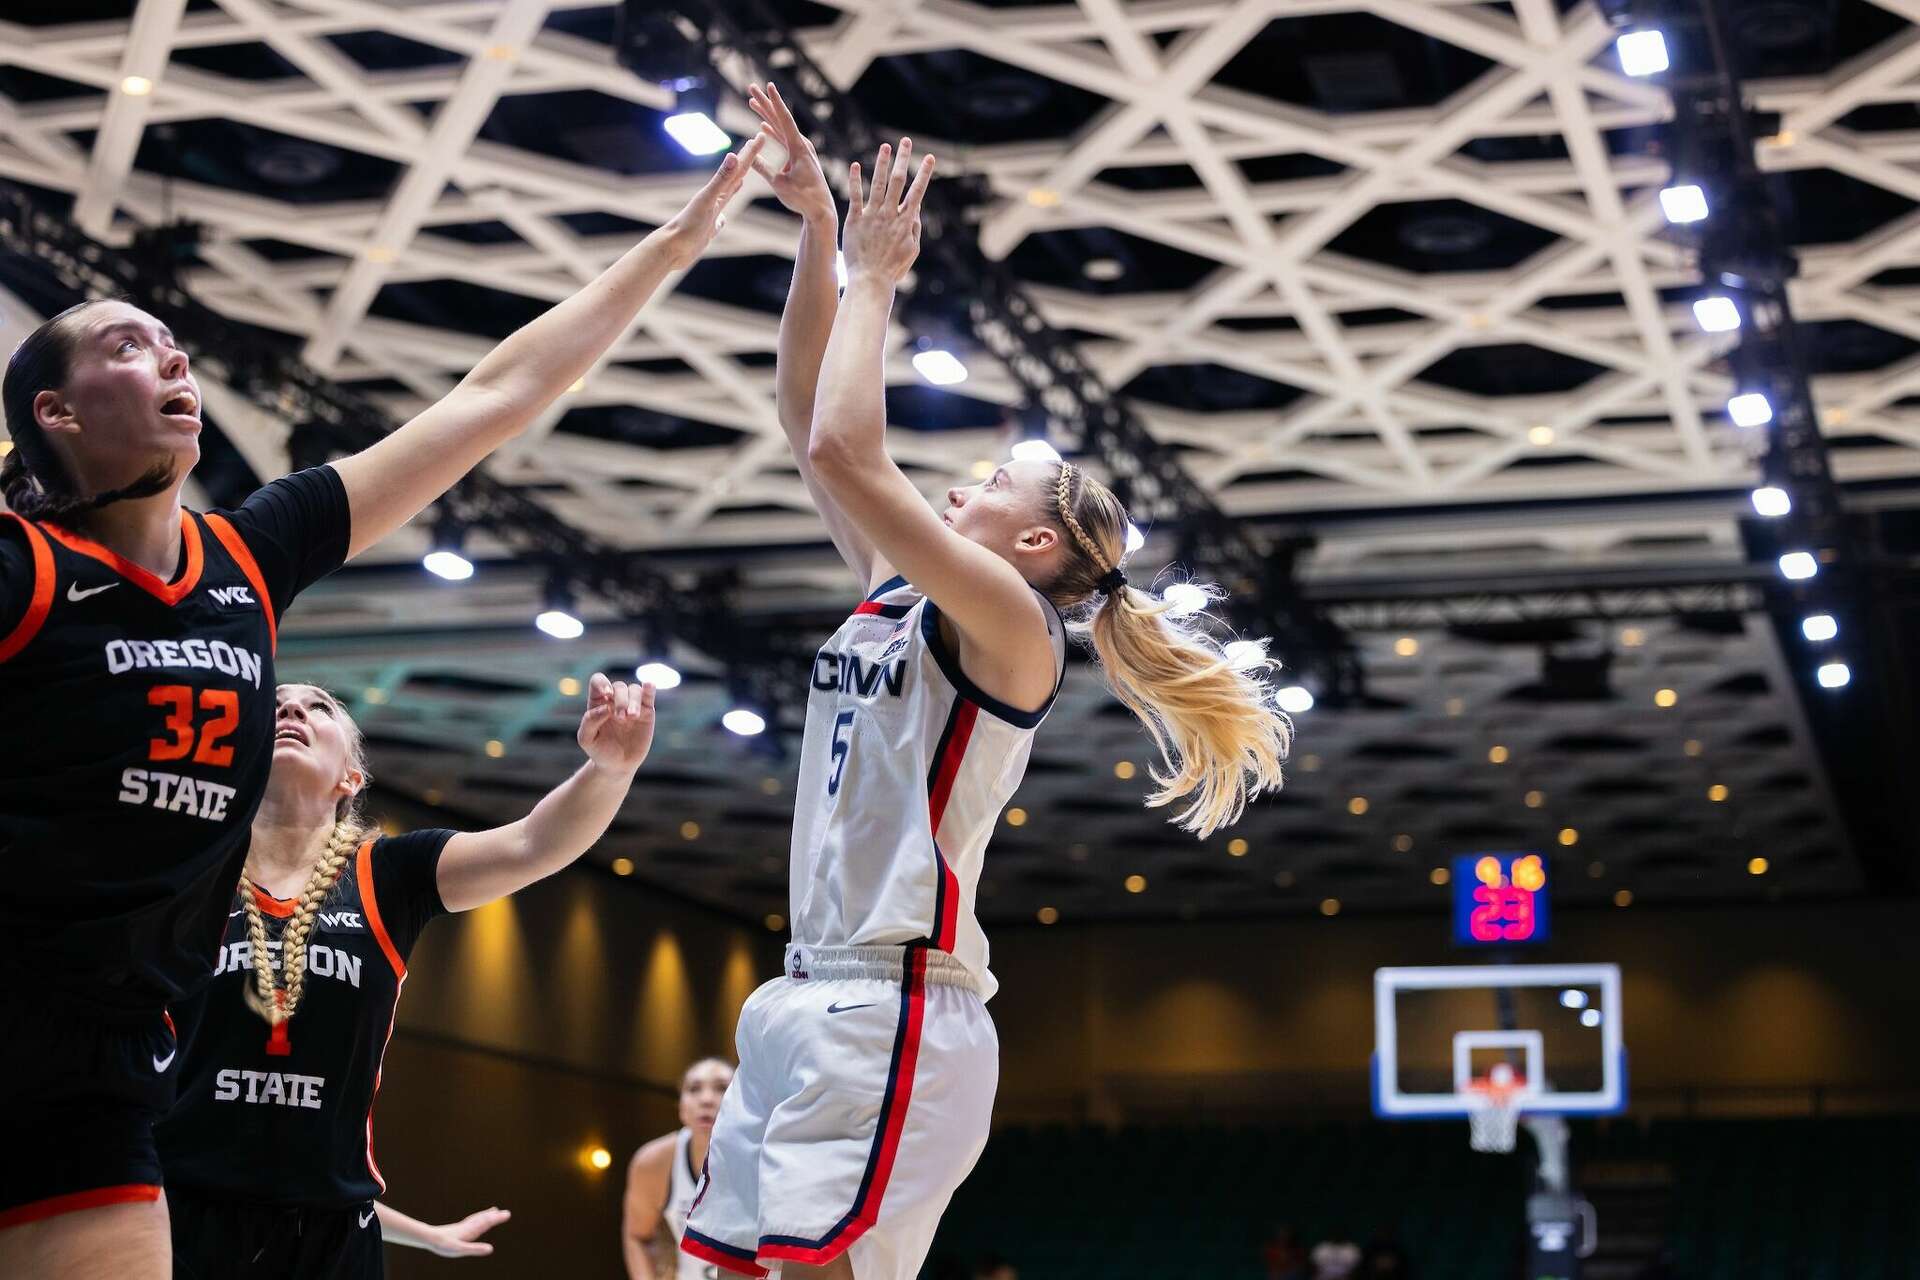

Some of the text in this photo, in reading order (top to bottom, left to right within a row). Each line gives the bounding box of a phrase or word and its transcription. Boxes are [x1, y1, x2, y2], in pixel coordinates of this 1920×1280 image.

[105, 639, 261, 690] OREGON
[147, 685, 240, 767] 32
[828, 710, 856, 796] 5
[118, 767, 236, 822] STATE
[213, 941, 362, 988] REON
[214, 1068, 325, 1110] STATE
